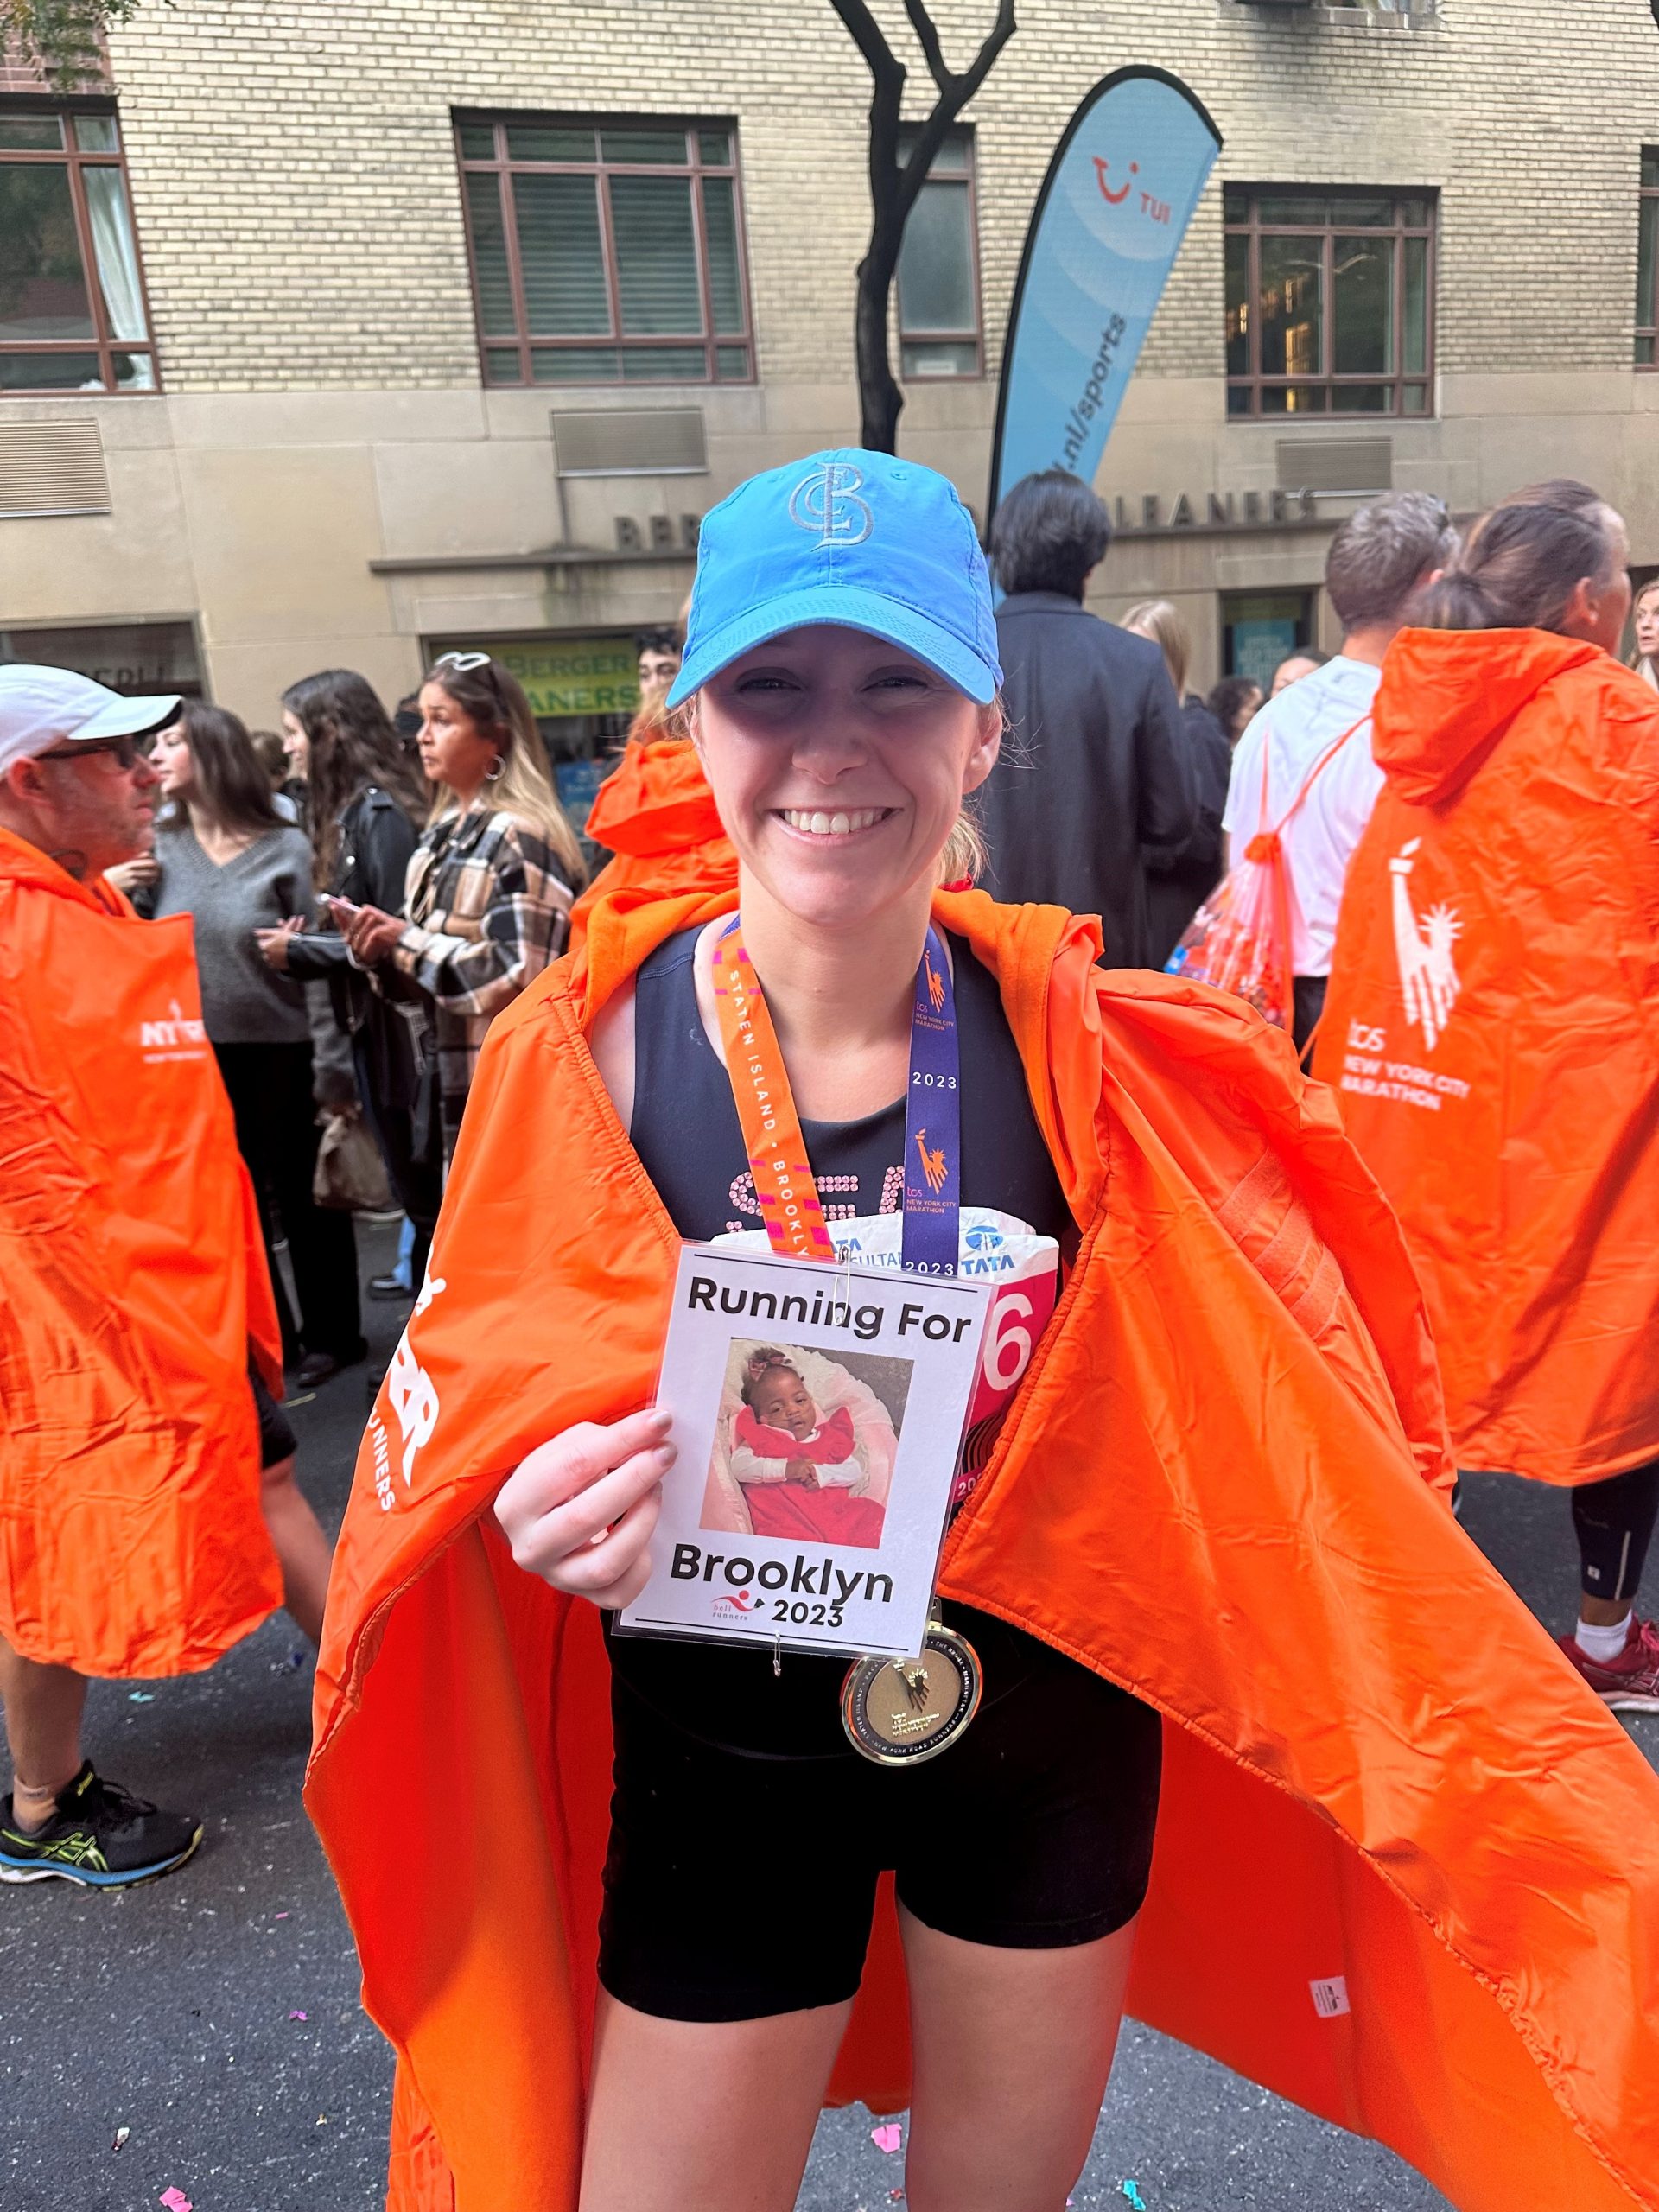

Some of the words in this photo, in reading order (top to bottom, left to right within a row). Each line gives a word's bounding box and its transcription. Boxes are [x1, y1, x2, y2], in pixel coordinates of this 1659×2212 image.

[1140, 191, 1171, 225] TUI
[915, 1019, 945, 1031] MARATHON
[729, 969, 755, 1046] STATEN
[747, 1054, 776, 1131] ISLAND
[912, 1071, 957, 1089] 2023
[1340, 1074, 1442, 1111] MARATHON
[1385, 1061, 1436, 1090] YORK
[1434, 1075, 1471, 1100] CITY
[906, 1205, 944, 1214] MARATHON
[905, 1261, 954, 1277] 2023
[961, 1255, 1015, 1275] TATA
[688, 1275, 884, 1340] Running
[898, 1303, 972, 1343] For
[983, 1292, 1033, 1390] 6
[671, 1543, 893, 1605] Brooklyn
[713, 1611, 747, 1621] runners
[714, 1603, 732, 1611] bell
[772, 1599, 844, 1628] 2023
